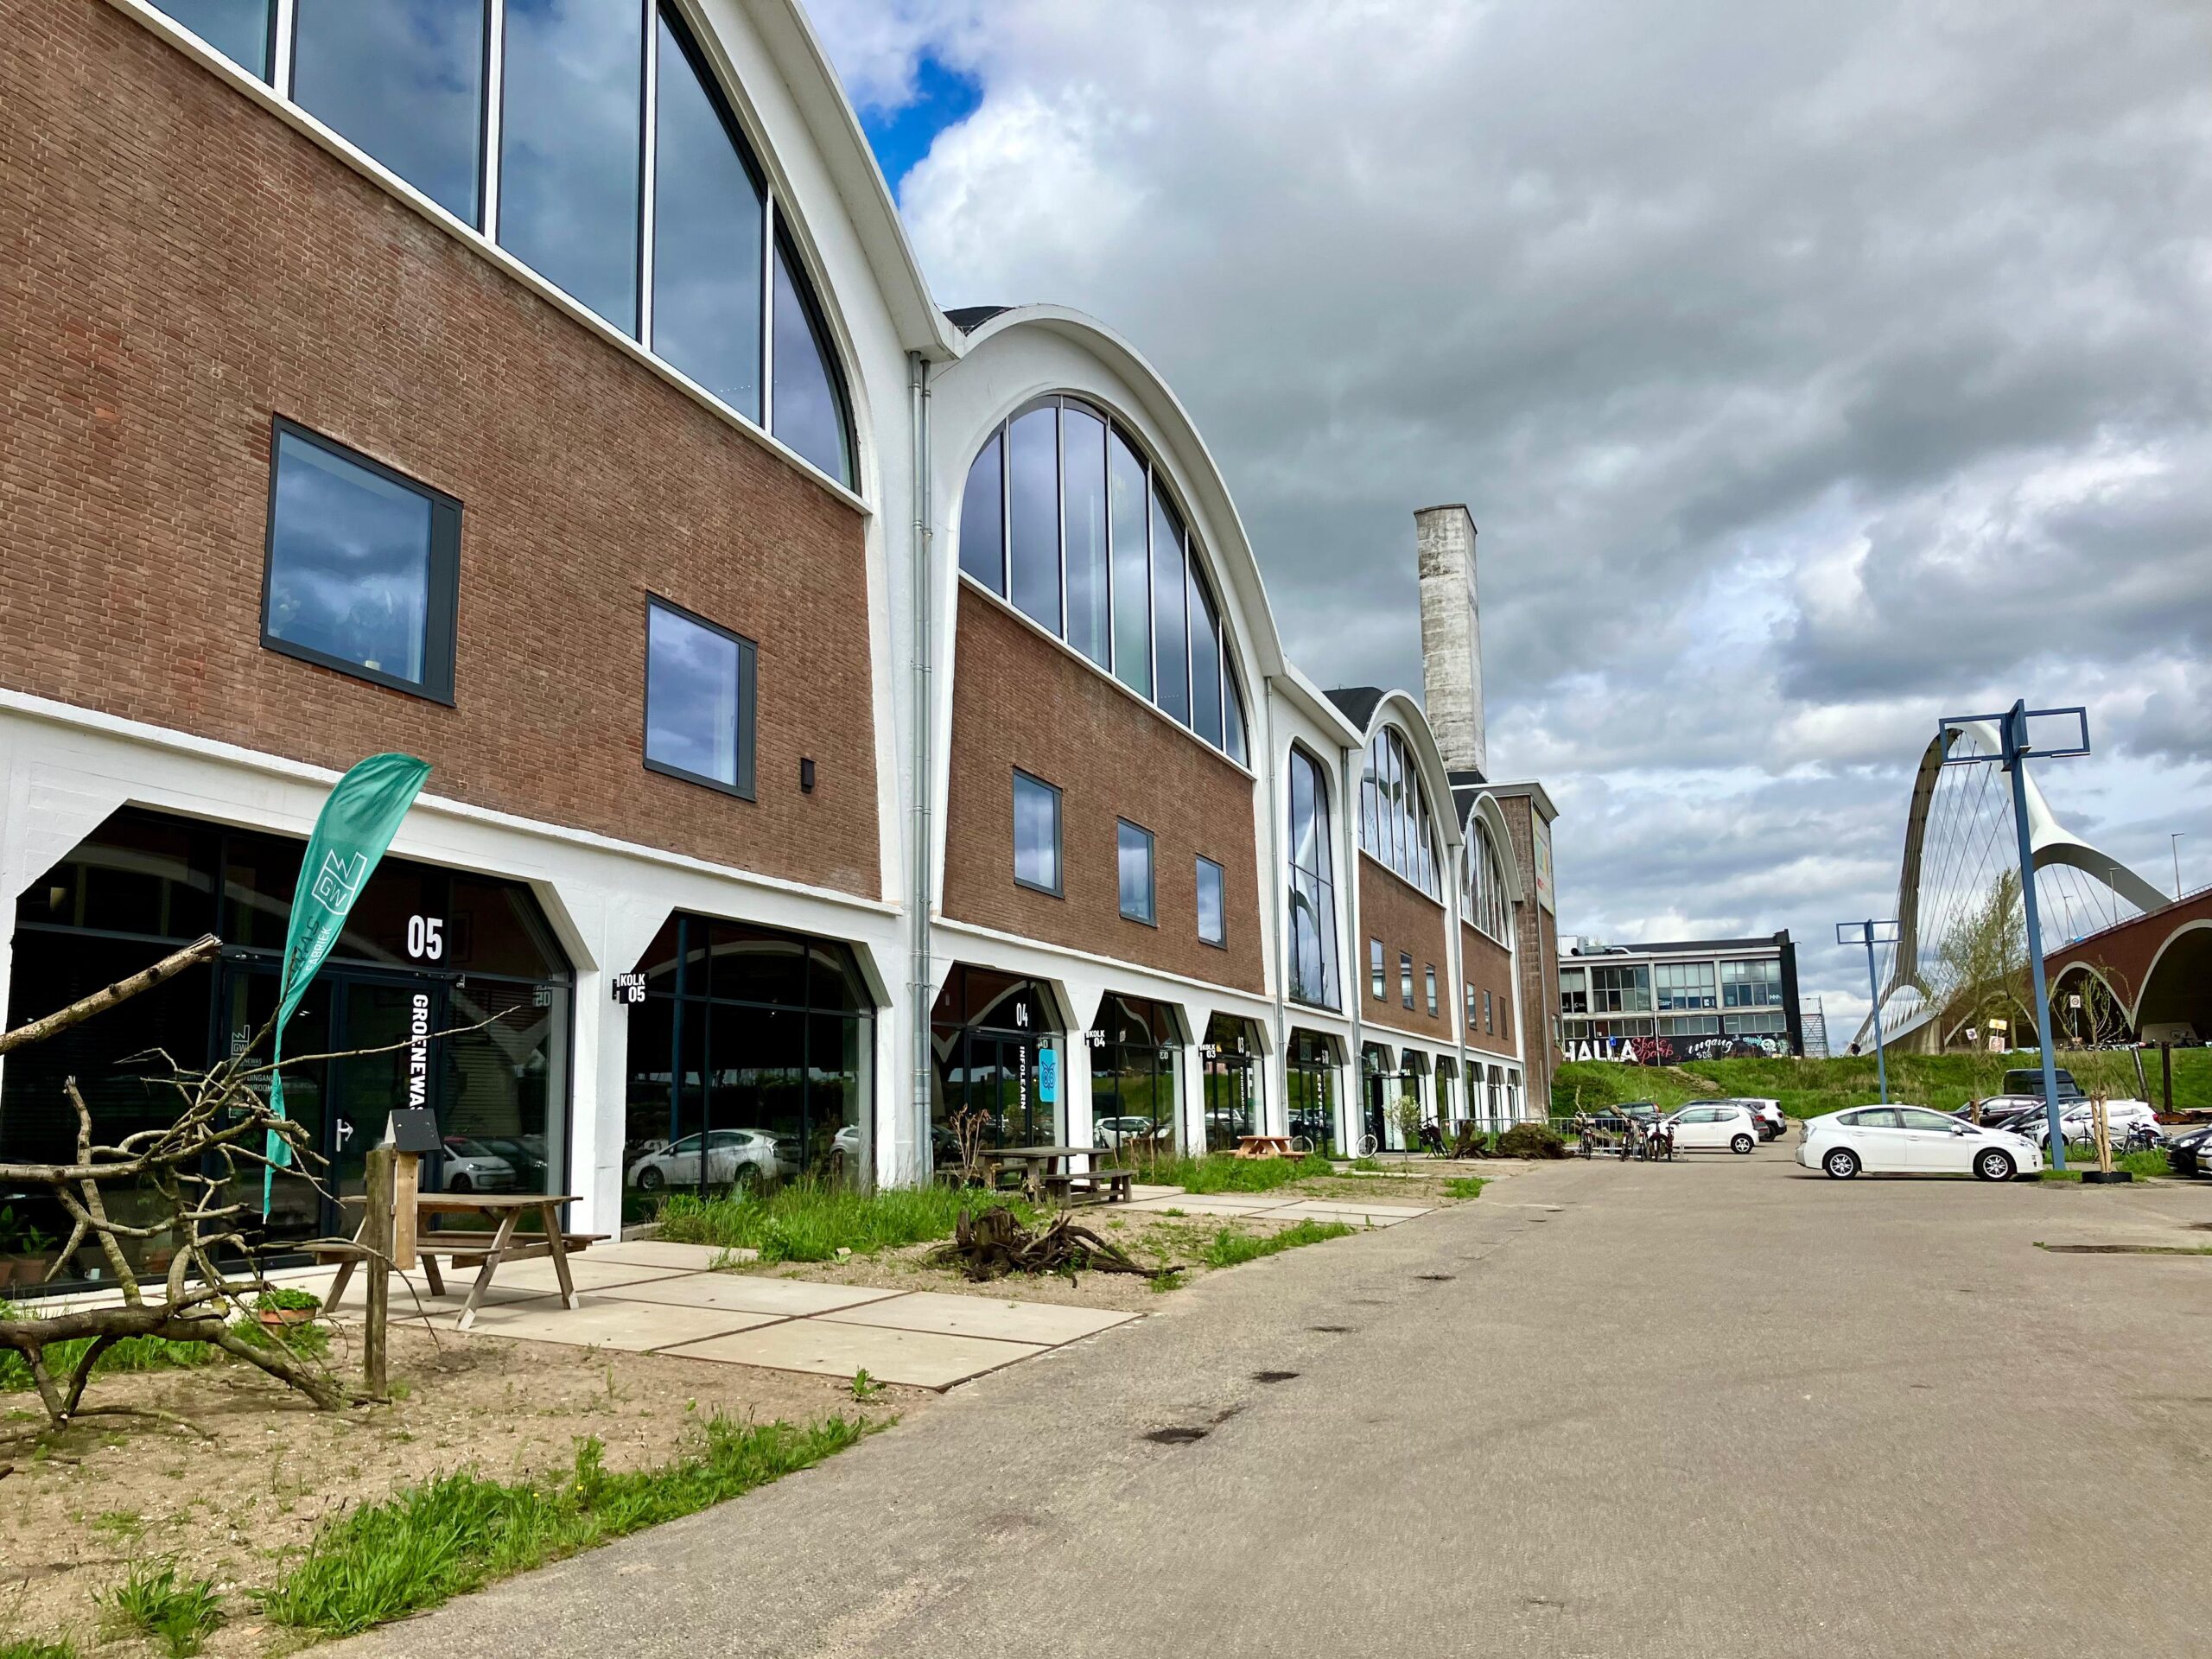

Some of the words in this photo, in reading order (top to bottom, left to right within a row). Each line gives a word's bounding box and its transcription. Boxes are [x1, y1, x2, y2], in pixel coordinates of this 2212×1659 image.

[320, 875, 347, 907] GW
[407, 914, 443, 960] 05
[620, 973, 646, 987] KOLK
[628, 985, 646, 1003] 05
[1016, 1002, 1028, 1027] 04
[1089, 1029, 1105, 1038] KOLK
[1094, 1037, 1106, 1047] 04
[409, 994, 429, 1110] GROENEWA
[1206, 1050, 1216, 1058] 03
